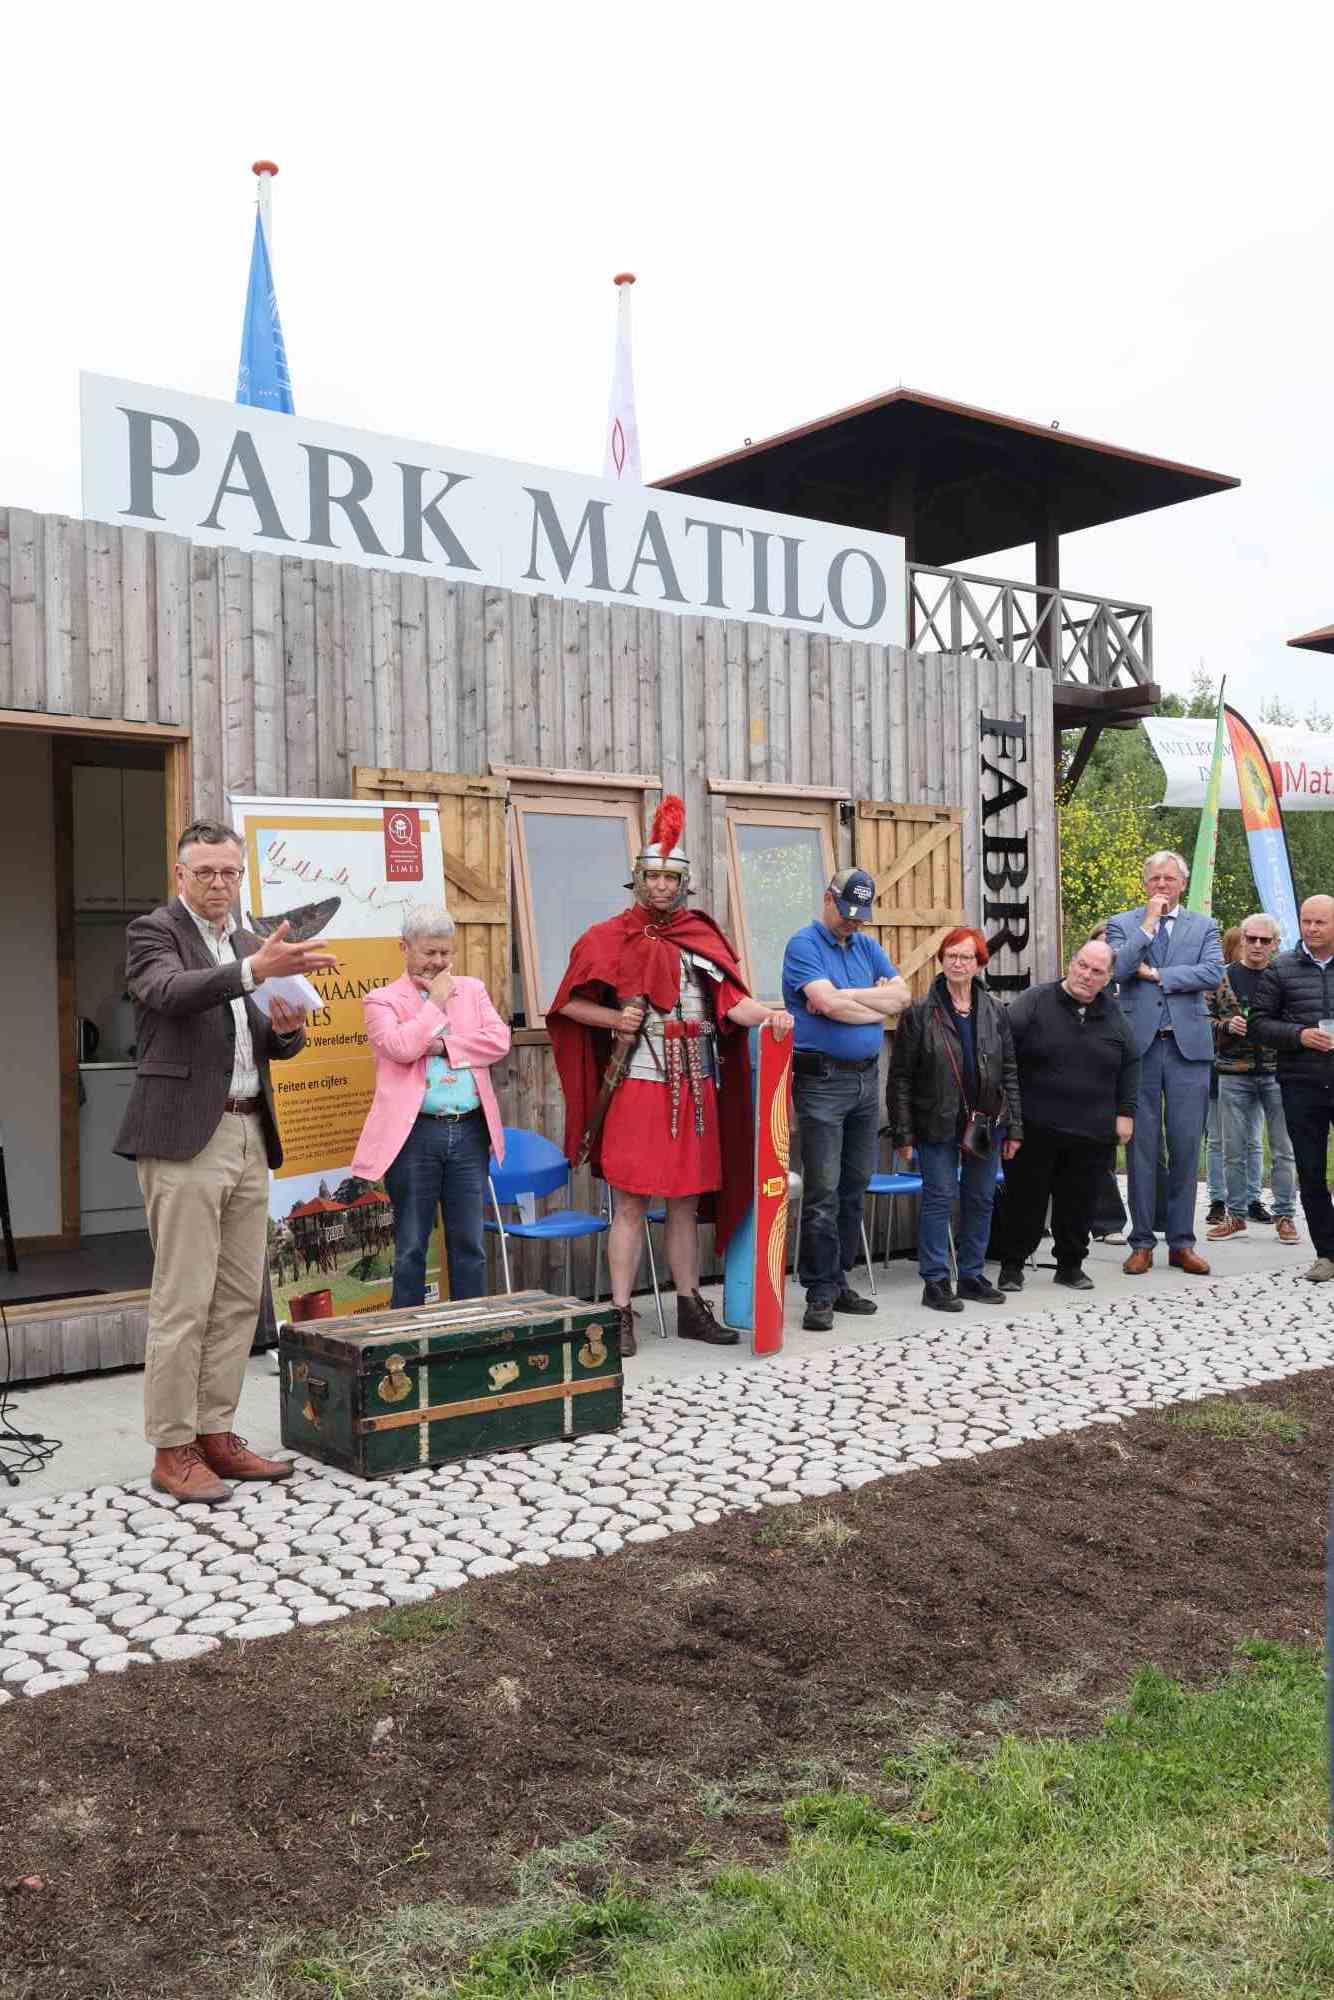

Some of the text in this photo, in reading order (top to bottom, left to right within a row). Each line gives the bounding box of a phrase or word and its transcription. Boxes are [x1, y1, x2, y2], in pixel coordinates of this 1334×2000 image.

[115, 406, 888, 631] PARK MATILO
[278, 1075, 348, 1094] Feiten en cijfers
